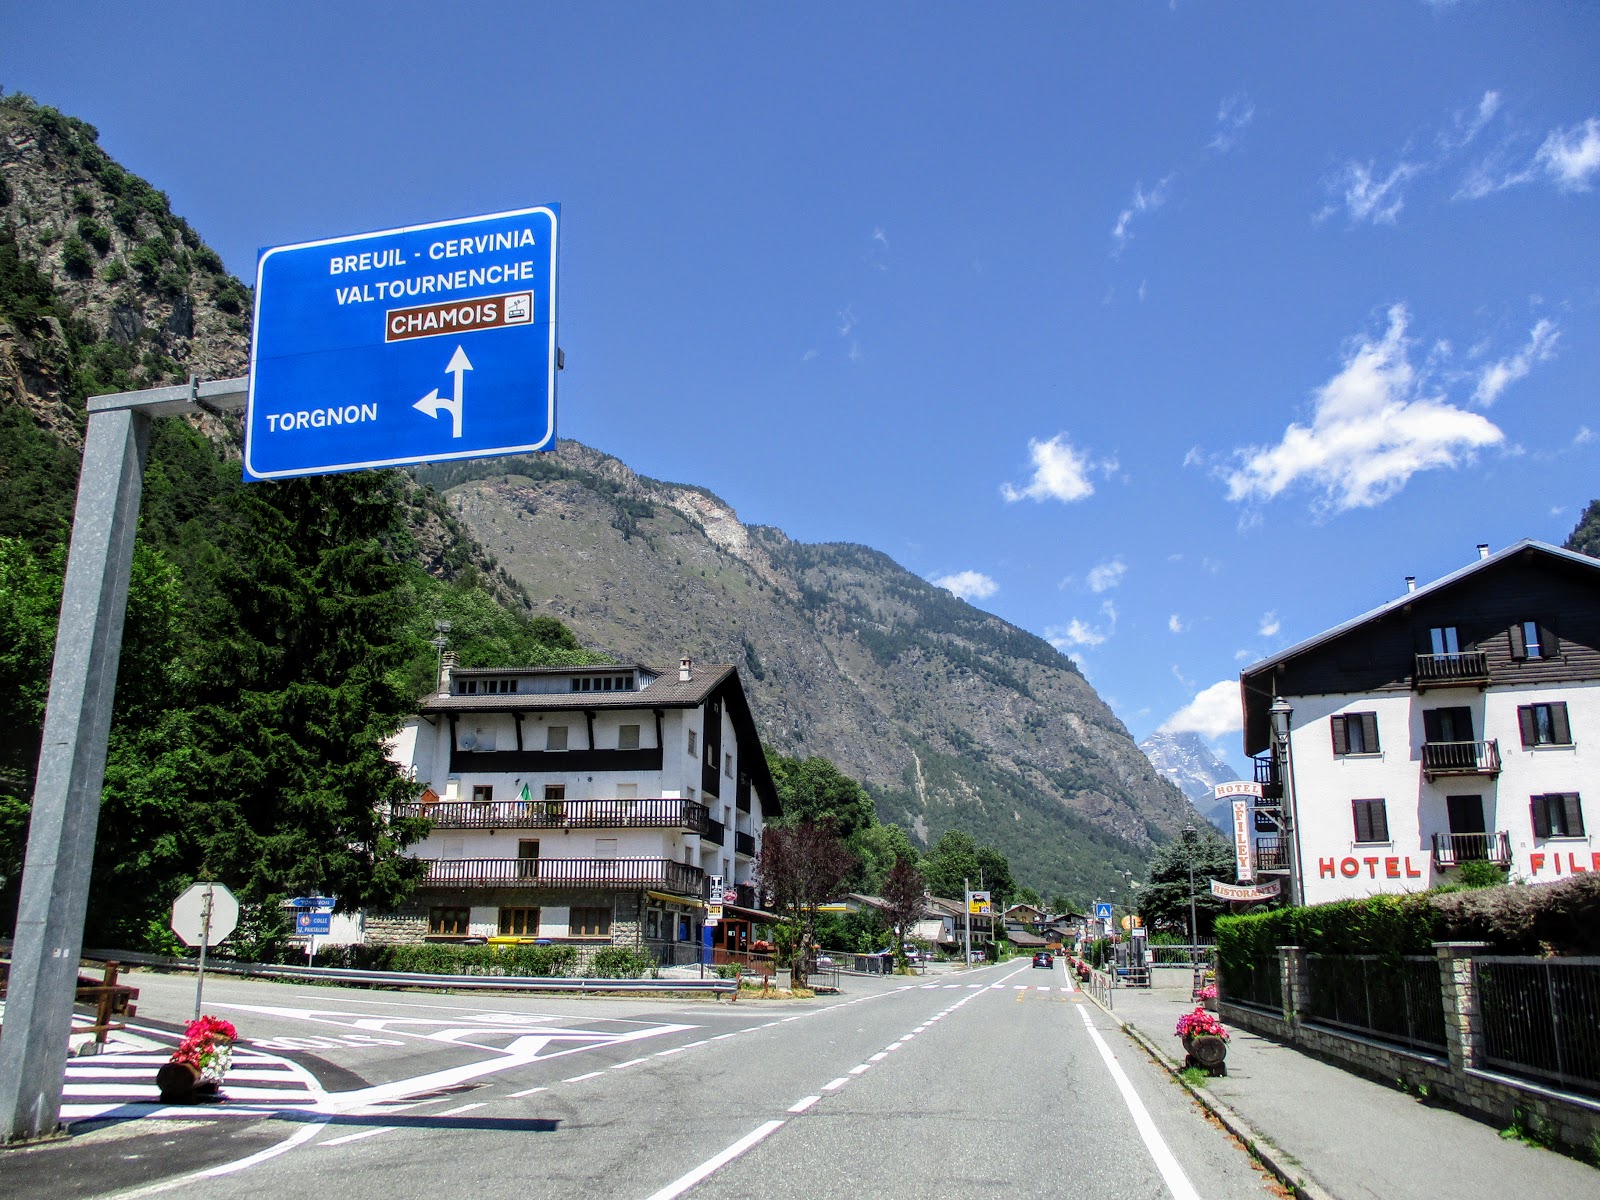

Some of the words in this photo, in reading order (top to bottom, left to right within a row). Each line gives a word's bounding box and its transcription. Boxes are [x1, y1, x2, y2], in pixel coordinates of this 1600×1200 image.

[330, 249, 406, 275] BREUIL
[429, 228, 535, 260] CERVINIA
[335, 261, 534, 305] VALTOURNENCHE
[391, 303, 497, 334] CHAMOIS
[266, 403, 377, 433] TORGNON
[1216, 784, 1259, 795] HOTEL
[1235, 810, 1248, 868] FILEY
[1318, 856, 1421, 879] HOTEL
[1213, 883, 1280, 898] RISTORANTE
